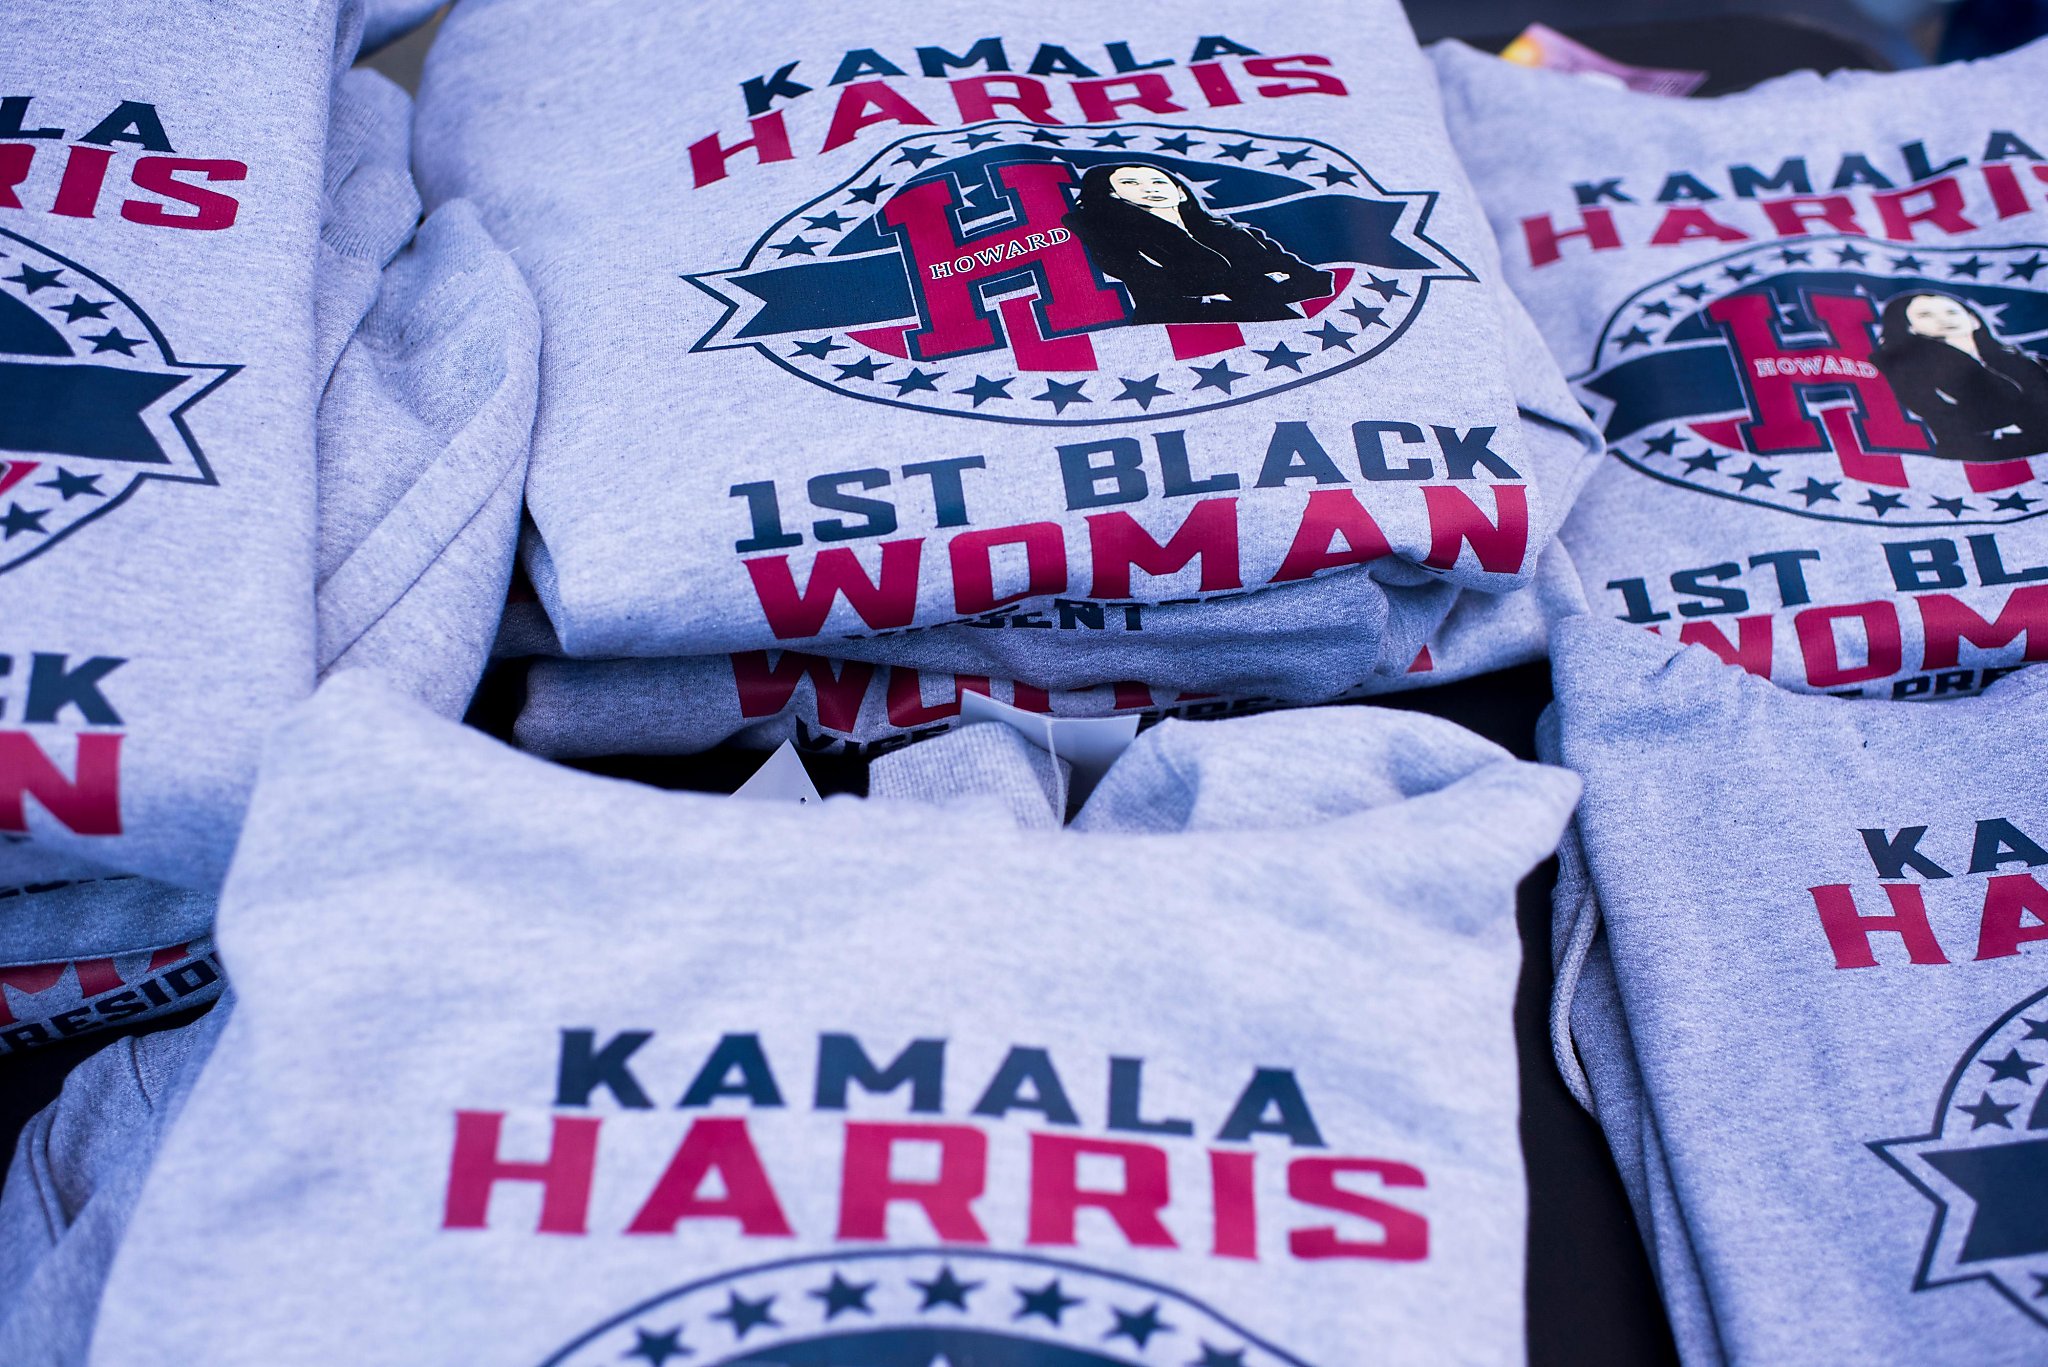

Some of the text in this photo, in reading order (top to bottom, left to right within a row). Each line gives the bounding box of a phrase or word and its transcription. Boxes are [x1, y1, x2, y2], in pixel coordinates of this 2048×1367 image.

[687, 54, 1349, 190] HARRIS
[741, 36, 1261, 117] KAMALA
[1521, 163, 2048, 268] HARRI
[1572, 130, 2047, 206] KAMALA
[929, 227, 1071, 280] HOWARD
[1753, 354, 1879, 379] HOWARD
[728, 420, 1523, 554] 1ST BLACK
[742, 484, 1528, 640] WOMAN
[1605, 533, 2048, 624] 1ST BL
[1857, 818, 2048, 880] KA
[1807, 873, 2048, 970] HA
[553, 1028, 1326, 1147] KAMALA
[441, 1110, 1430, 1263] HARRIS
